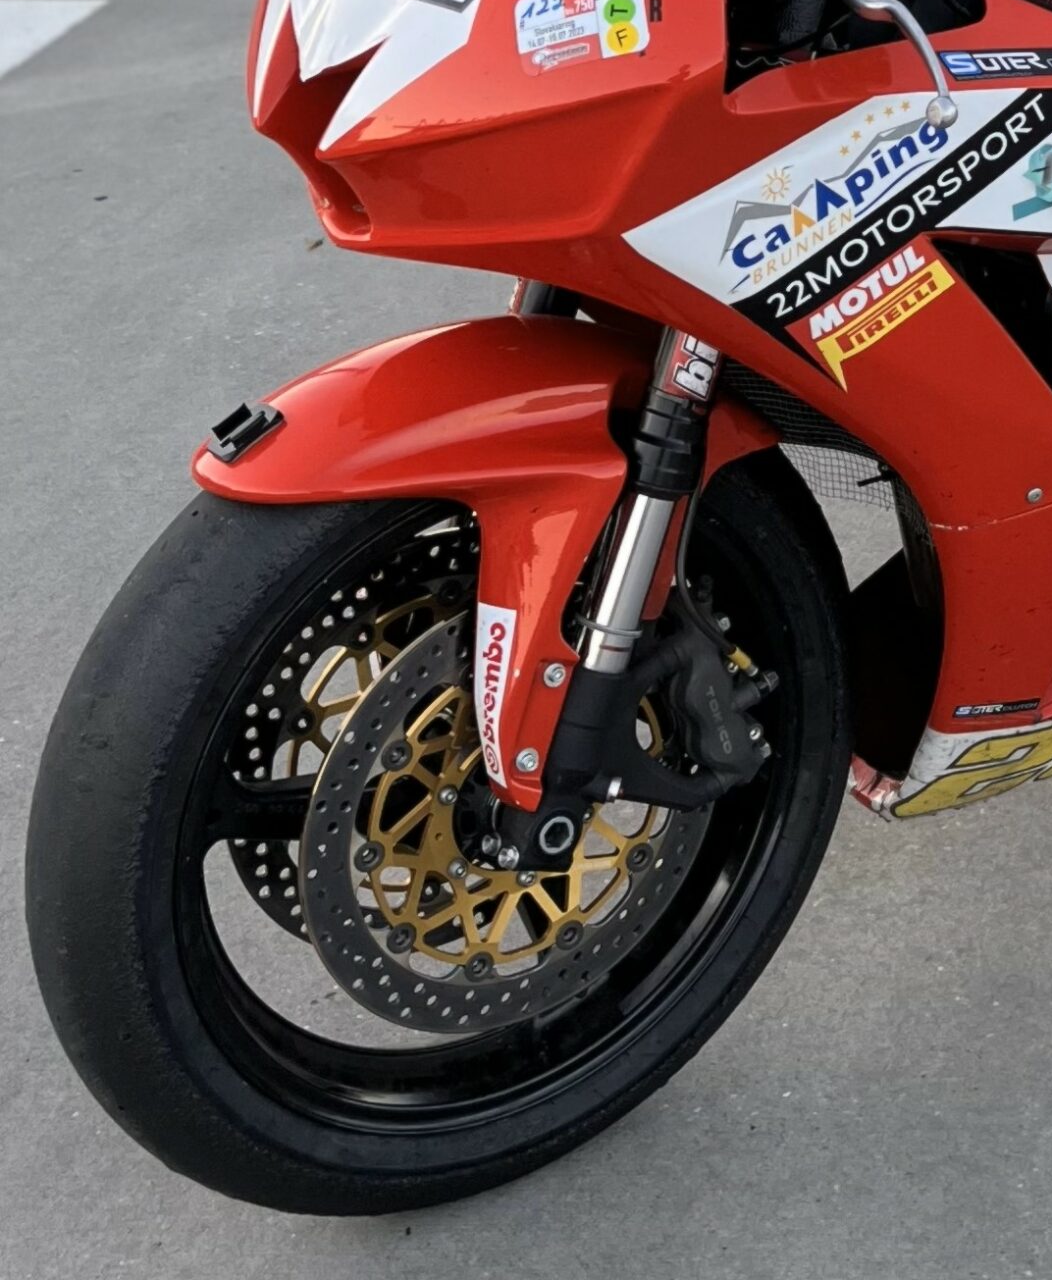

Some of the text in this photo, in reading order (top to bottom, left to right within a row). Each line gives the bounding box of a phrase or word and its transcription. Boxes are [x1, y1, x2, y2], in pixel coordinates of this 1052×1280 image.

[615, 28, 629, 48] F
[940, 51, 1048, 77] SUTER
[752, 208, 852, 285] BRUNNEN
[766, 92, 1051, 318] 22MOTORSPORT
[809, 246, 926, 340] MOTUL
[834, 270, 938, 354] PIRELLI
[482, 621, 507, 745] brembo
